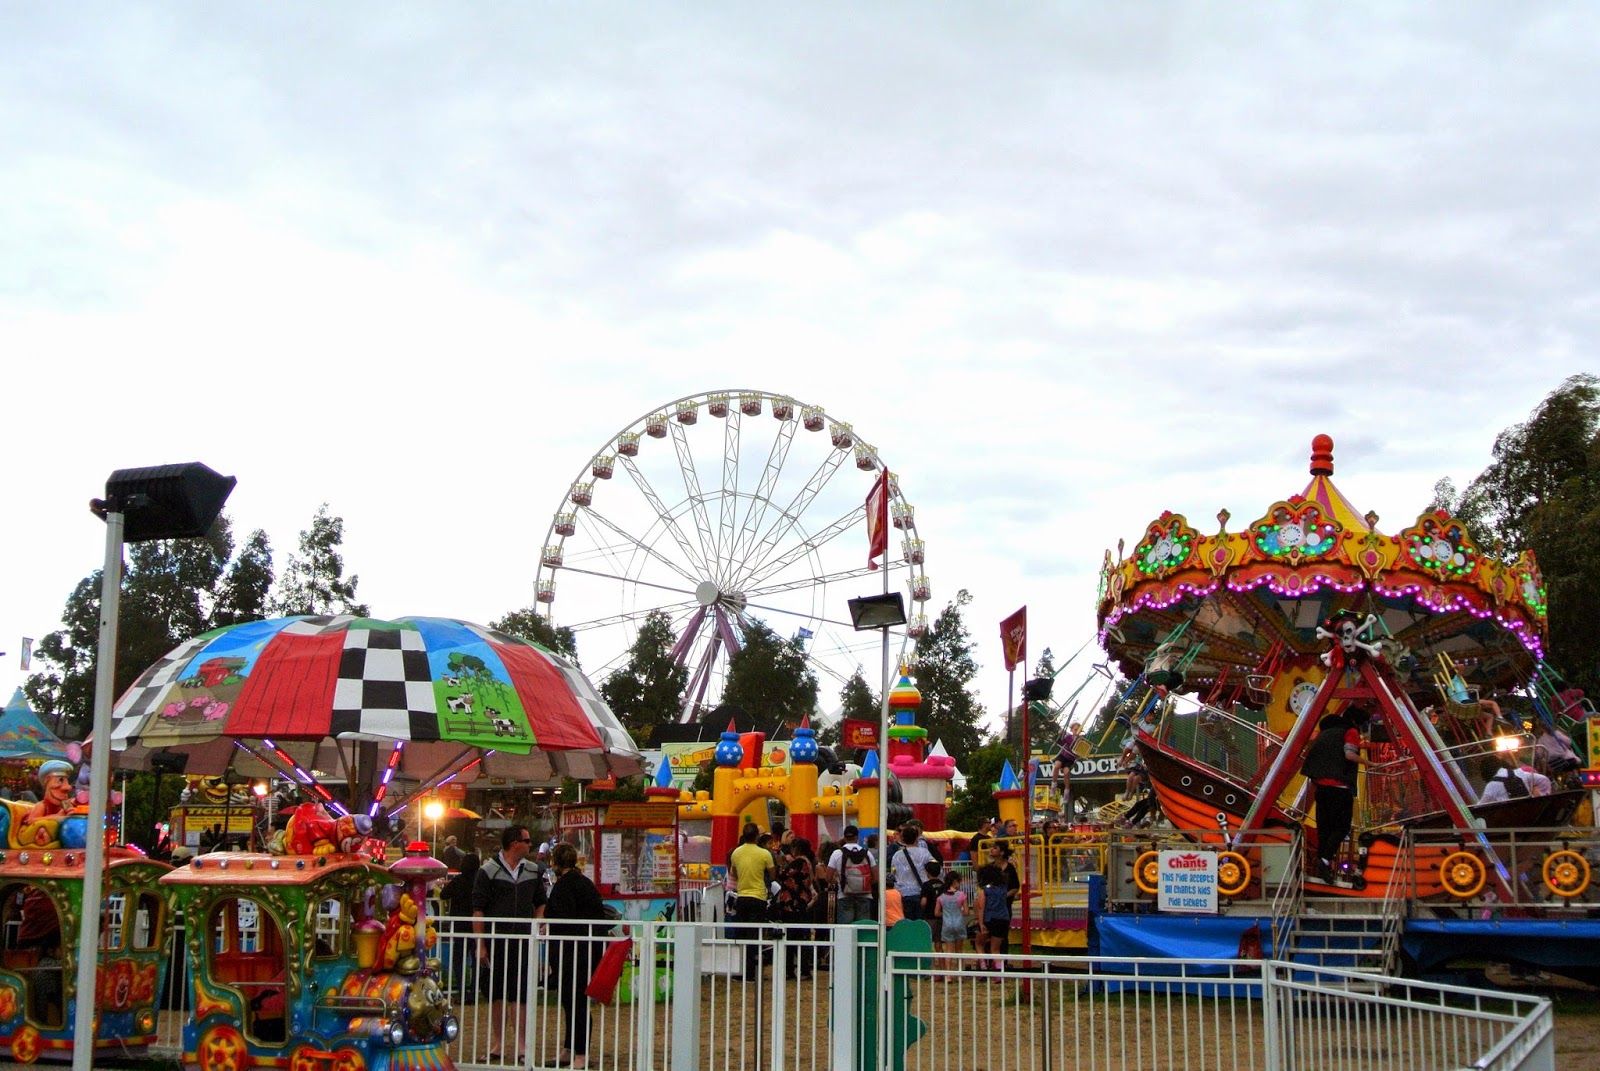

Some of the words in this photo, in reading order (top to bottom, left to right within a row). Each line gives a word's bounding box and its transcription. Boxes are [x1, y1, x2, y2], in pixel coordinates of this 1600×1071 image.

[563, 810, 594, 826] TICKETS
[1168, 857, 1207, 868] Chants
[1189, 873, 1214, 883] accepts
[1197, 886, 1211, 895] kids
[1182, 898, 1207, 907] tickets
